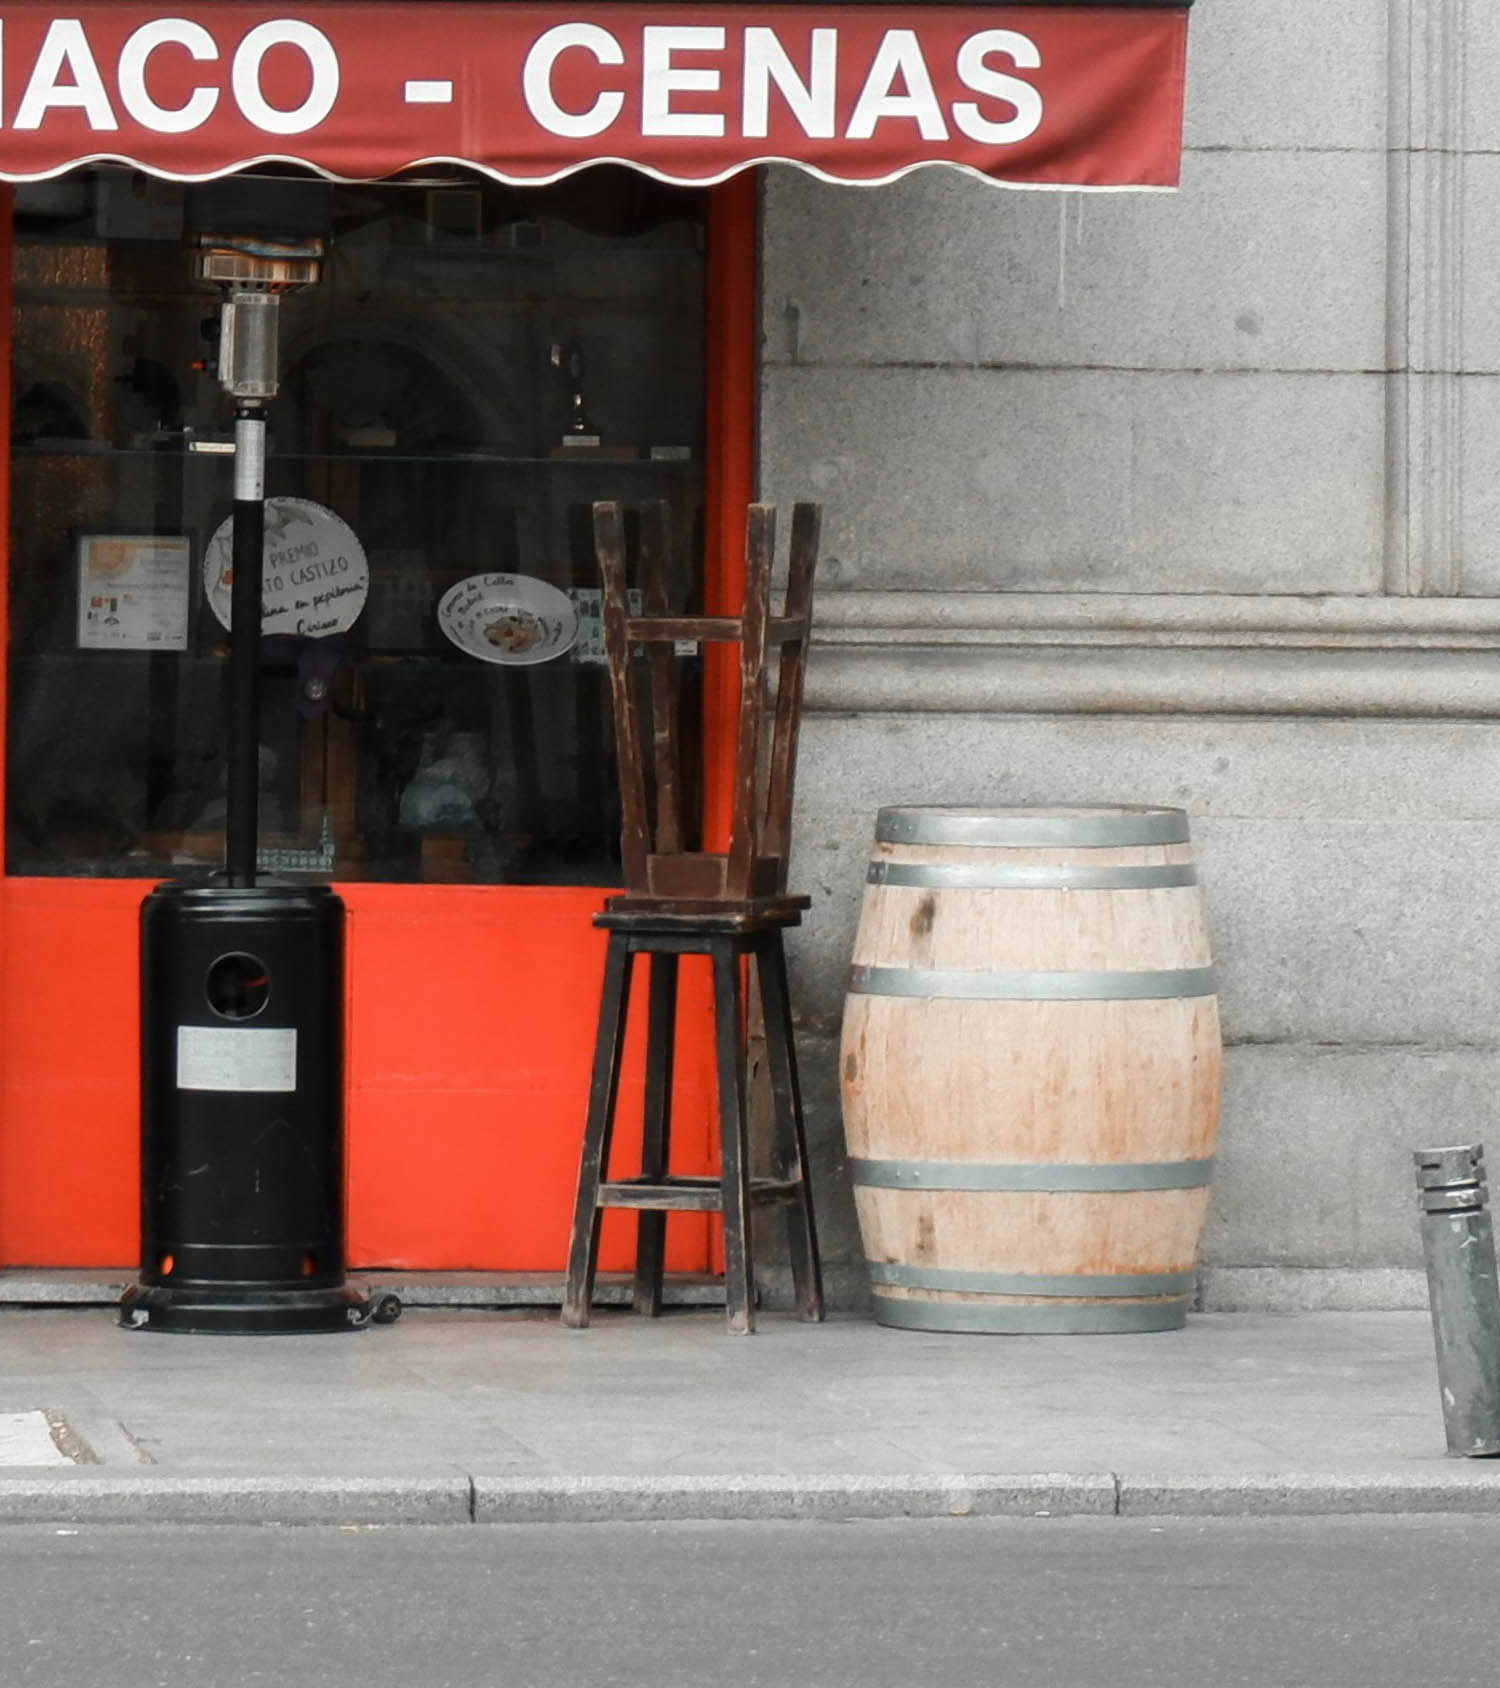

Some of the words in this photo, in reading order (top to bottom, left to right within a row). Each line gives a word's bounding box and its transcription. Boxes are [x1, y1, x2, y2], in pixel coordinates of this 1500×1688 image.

[523, 23, 1042, 144] CENAS
[269, 541, 319, 569] PREMIO
[290, 556, 349, 586] CASTIZO
